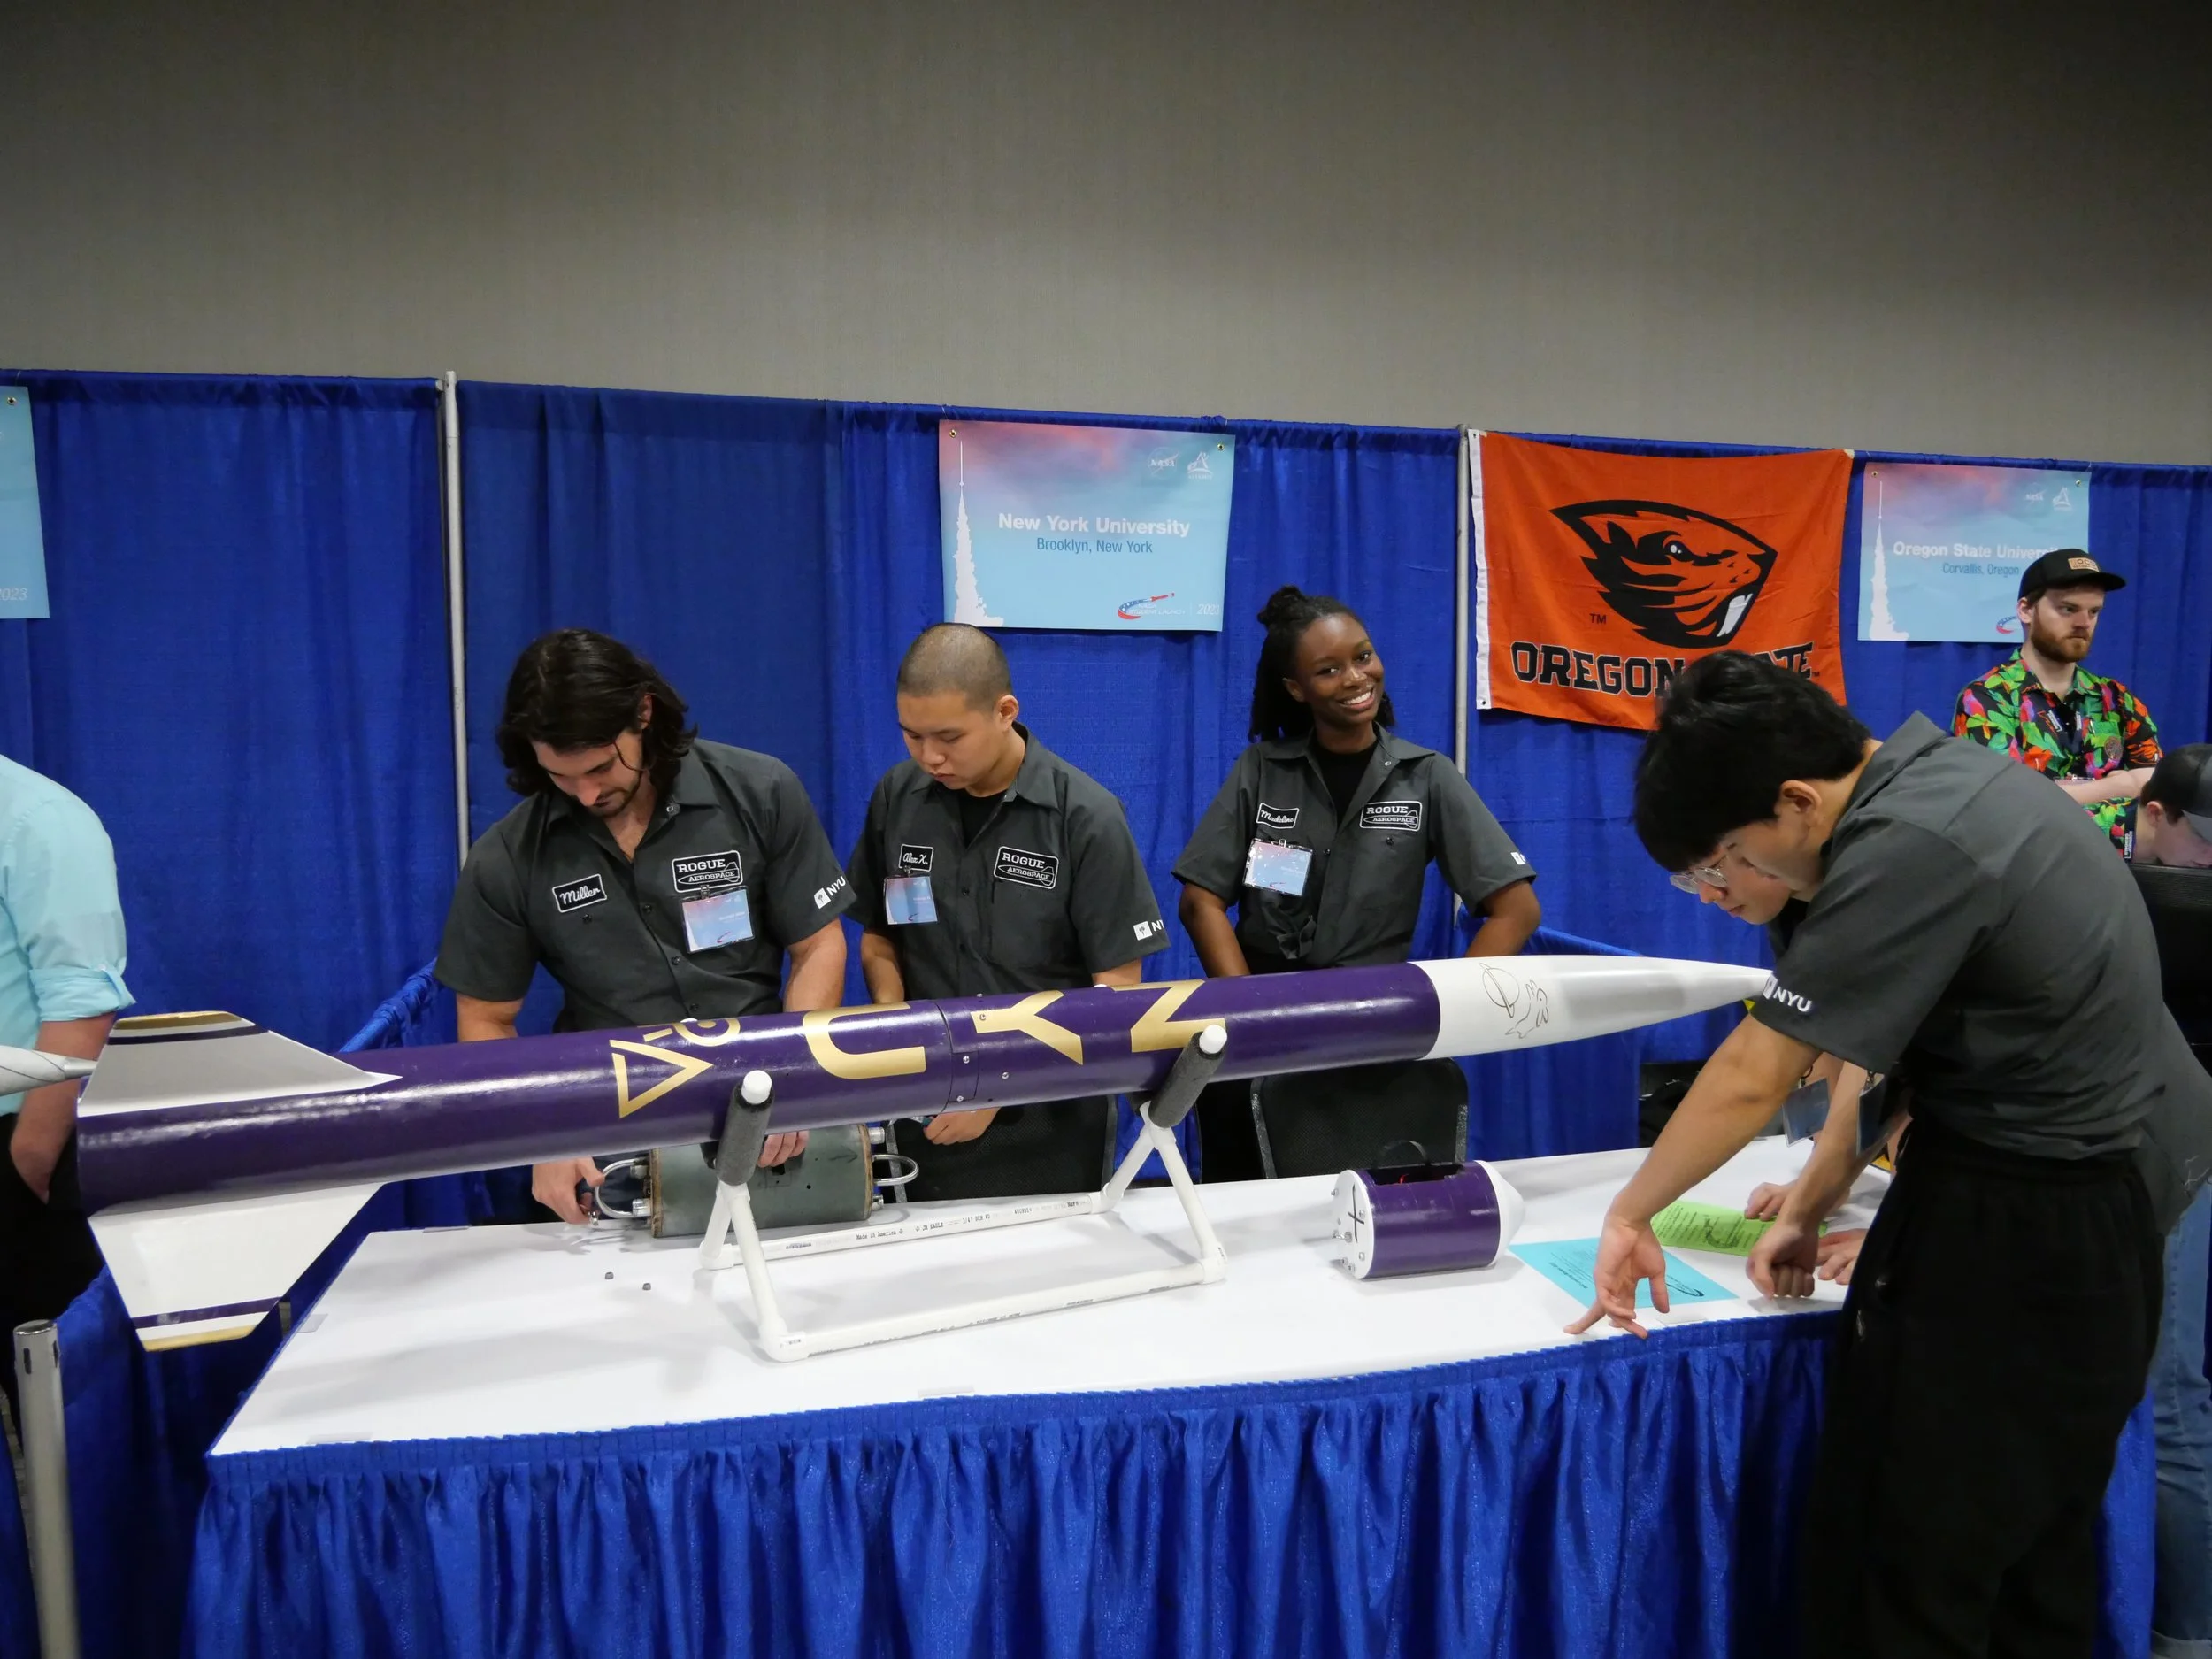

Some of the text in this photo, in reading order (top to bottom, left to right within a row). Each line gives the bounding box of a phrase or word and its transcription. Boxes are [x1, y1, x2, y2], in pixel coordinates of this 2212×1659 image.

[998, 512, 1190, 538] New York University
[1036, 537, 1153, 554] Brooklyn, New York
[1893, 541, 1947, 559] Oregon
[1953, 543, 1991, 558] State
[1942, 562, 2020, 578] Corvallis, Oregon
[0, 588, 27, 601] 023
[1590, 613, 1607, 625] TM
[1372, 816, 1416, 825] AEROSPACE
[677, 859, 726, 873] ROGUE
[1001, 852, 1045, 869] ROGUE
[687, 871, 736, 883] AEROSPACE
[1007, 866, 1050, 880] AEROSPACE
[826, 875, 847, 896] NYU
[559, 885, 601, 905] Miller
[1773, 986, 1813, 1012] NYU
